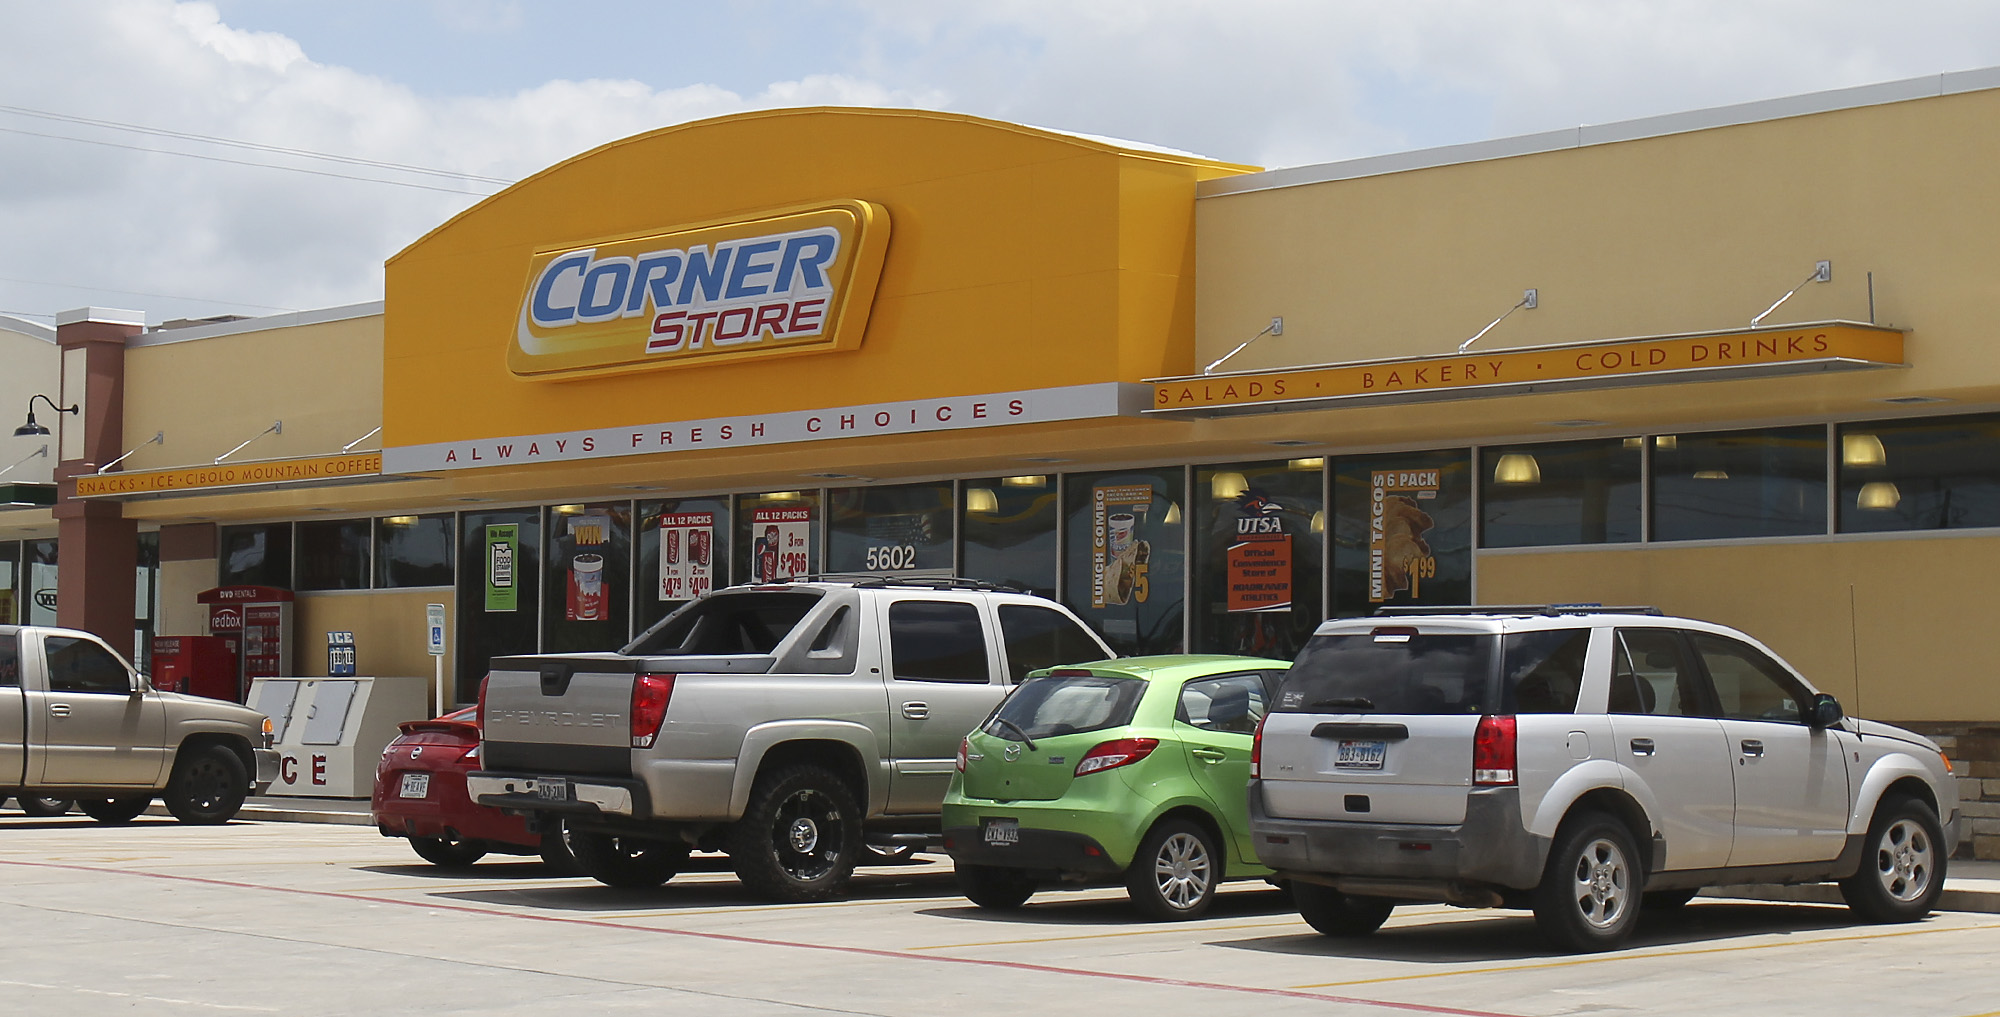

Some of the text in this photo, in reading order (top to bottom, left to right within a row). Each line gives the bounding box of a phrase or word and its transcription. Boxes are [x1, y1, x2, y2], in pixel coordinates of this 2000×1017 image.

[532, 233, 838, 323] CORNER
[648, 298, 826, 349] STORE
[1158, 332, 1831, 405] SALADS BAKERY COLD DRINKS
[445, 398, 1025, 464] ALWAYS FRESH CHOICES
[78, 457, 381, 494] SNACKS ICE CIBOLO MOUNTAIN COFFEE
[1386, 472, 1437, 487] 6 PACK
[662, 515, 712, 526] ALL 12 PACKS
[755, 510, 809, 520] ALL 12 PACKS
[1237, 516, 1283, 534] UTSA
[574, 525, 603, 545] WIN
[788, 532, 794, 547] 3
[794, 538, 804, 547] FOR
[1371, 474, 1385, 599] MINI TACOS
[1094, 489, 1105, 605] LUNCH COMBO
[496, 556, 511, 564] FOOD
[865, 545, 916, 571] 5602
[666, 566, 670, 575] 1
[692, 565, 697, 575] 2
[219, 589, 257, 599] DVD RENTALS
[211, 613, 241, 629] redbox
[328, 632, 354, 644] ICE
[490, 709, 621, 729] CHEVROLET
[281, 752, 327, 786] CE
